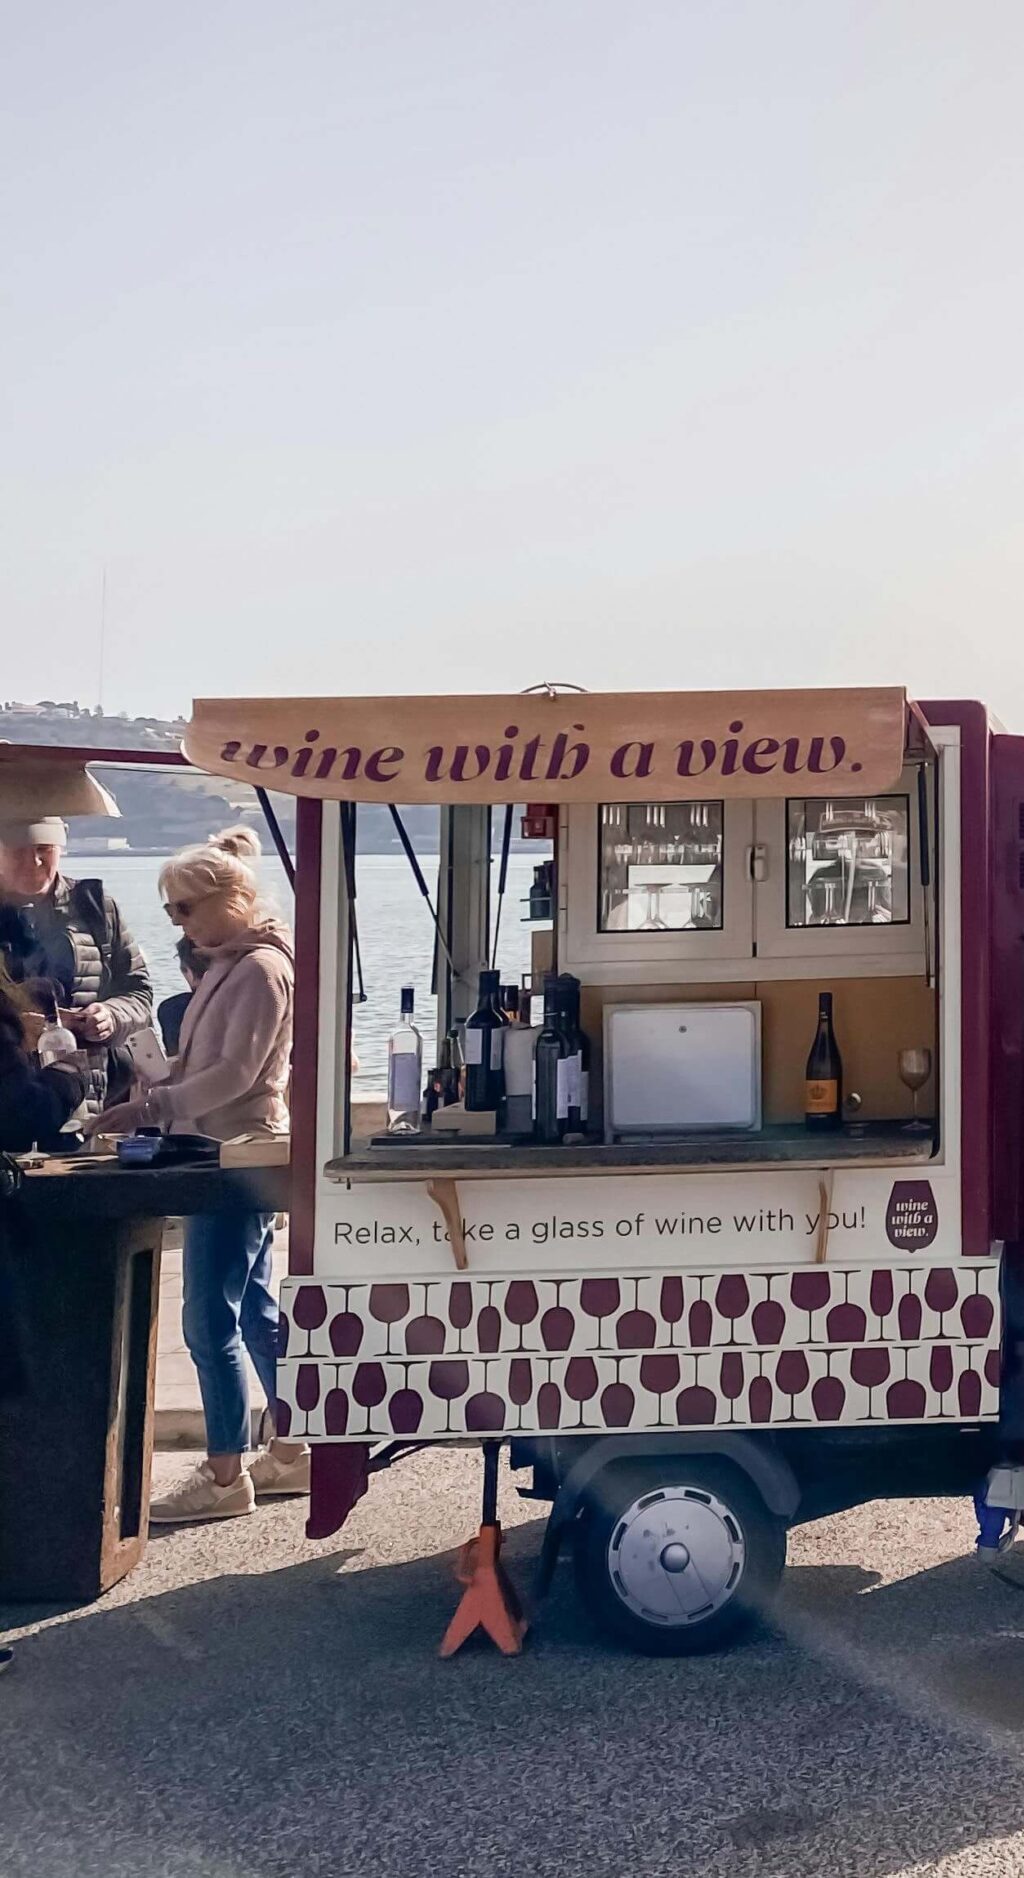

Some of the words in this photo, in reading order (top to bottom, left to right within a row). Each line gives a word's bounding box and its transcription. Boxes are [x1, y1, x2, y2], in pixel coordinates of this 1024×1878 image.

[220, 729, 404, 782] wine
[424, 724, 590, 782] with
[610, 741, 655, 778] a
[674, 720, 863, 776] view.
[896, 1198, 929, 1212] wine
[891, 1211, 921, 1225] with
[923, 1214, 933, 1224] a
[334, 1220, 420, 1247] Relax,
[505, 1223, 520, 1240] a
[531, 1216, 604, 1244] glass
[615, 1213, 645, 1237] of
[655, 1212, 722, 1236] wine
[733, 1209, 794, 1232] with
[894, 1224, 929, 1238] view.
